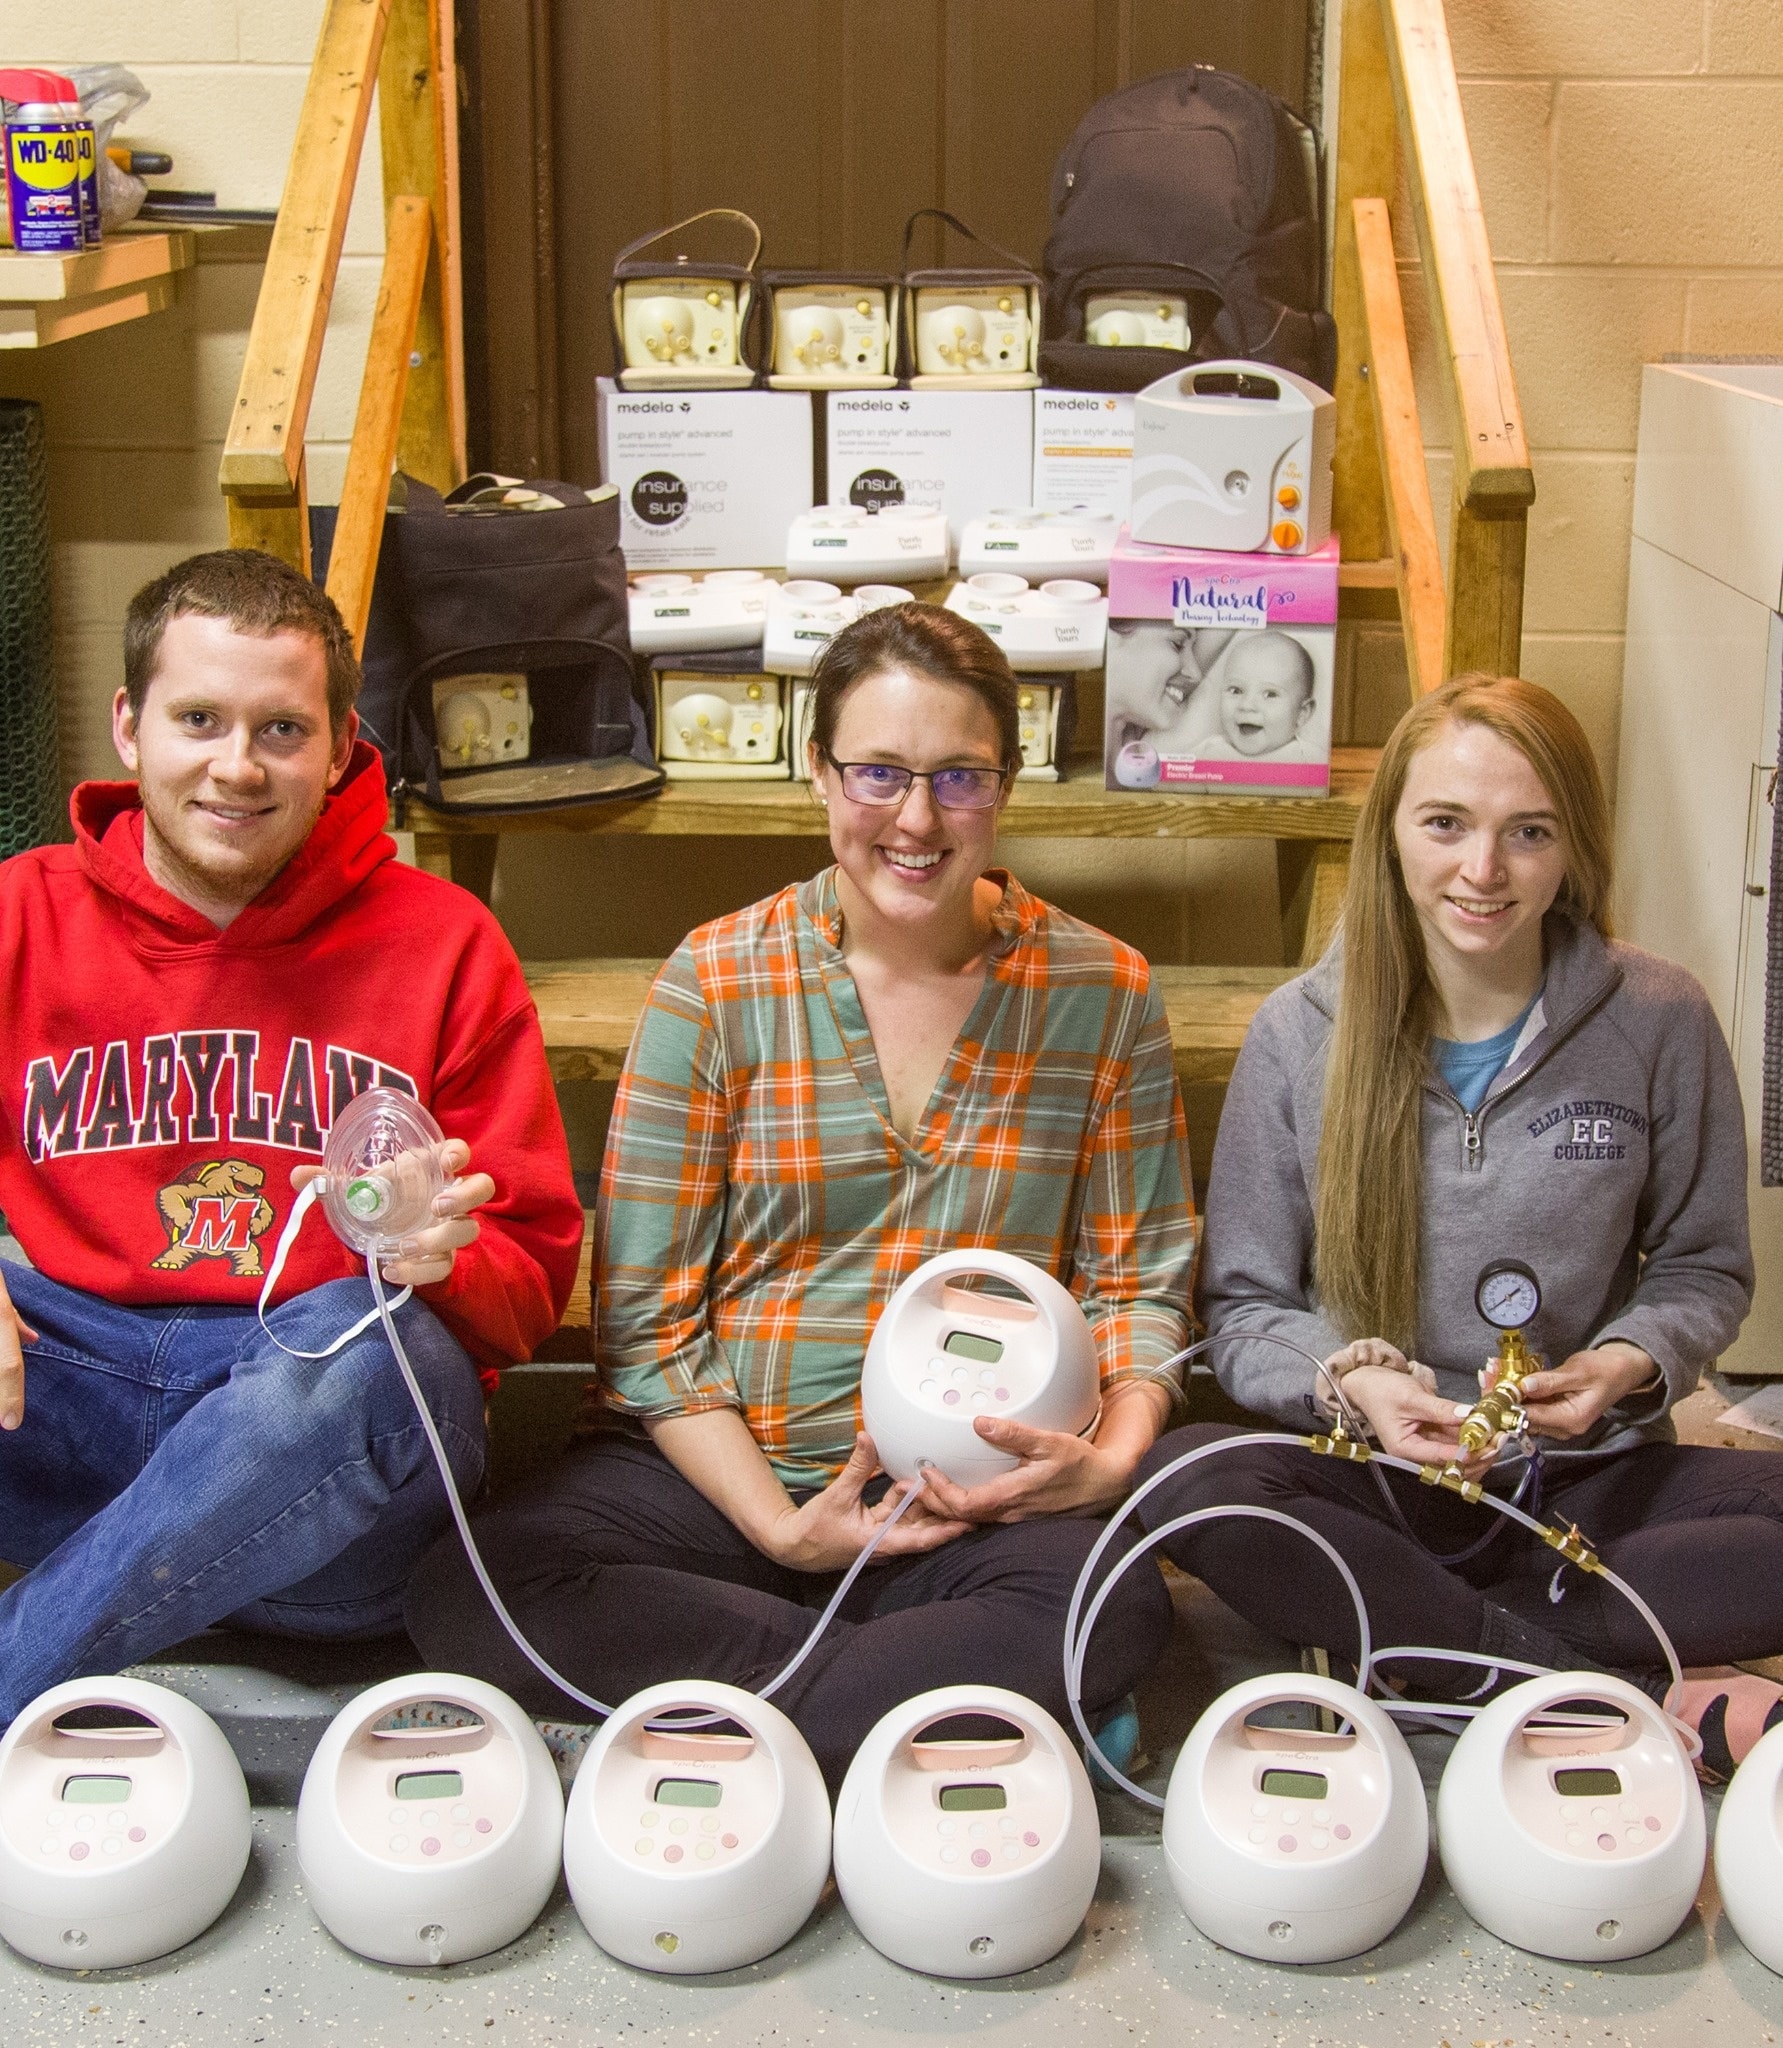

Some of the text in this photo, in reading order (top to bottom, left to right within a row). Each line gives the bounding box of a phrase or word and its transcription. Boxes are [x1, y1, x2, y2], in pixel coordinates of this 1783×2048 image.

[17, 139, 75, 164] WD-40
[617, 402, 674, 414] medela
[837, 400, 893, 412] medela
[1043, 399, 1099, 411] medela
[617, 431, 646, 441] pump
[649, 430, 657, 438] in
[687, 429, 733, 438] advanced
[837, 429, 863, 439] pump
[866, 428, 876, 437] in
[905, 428, 952, 438] advanced
[637, 480, 728, 494] insurance
[856, 477, 945, 491] insurance
[649, 500, 725, 517] supplied
[1172, 576, 1267, 611] Natural
[1527, 1100, 1648, 1138] ELIZABETHTOWN
[1570, 1117, 1613, 1144] EC
[1553, 1145, 1627, 1160] COLLEGE
[181, 1198, 260, 1252] M
